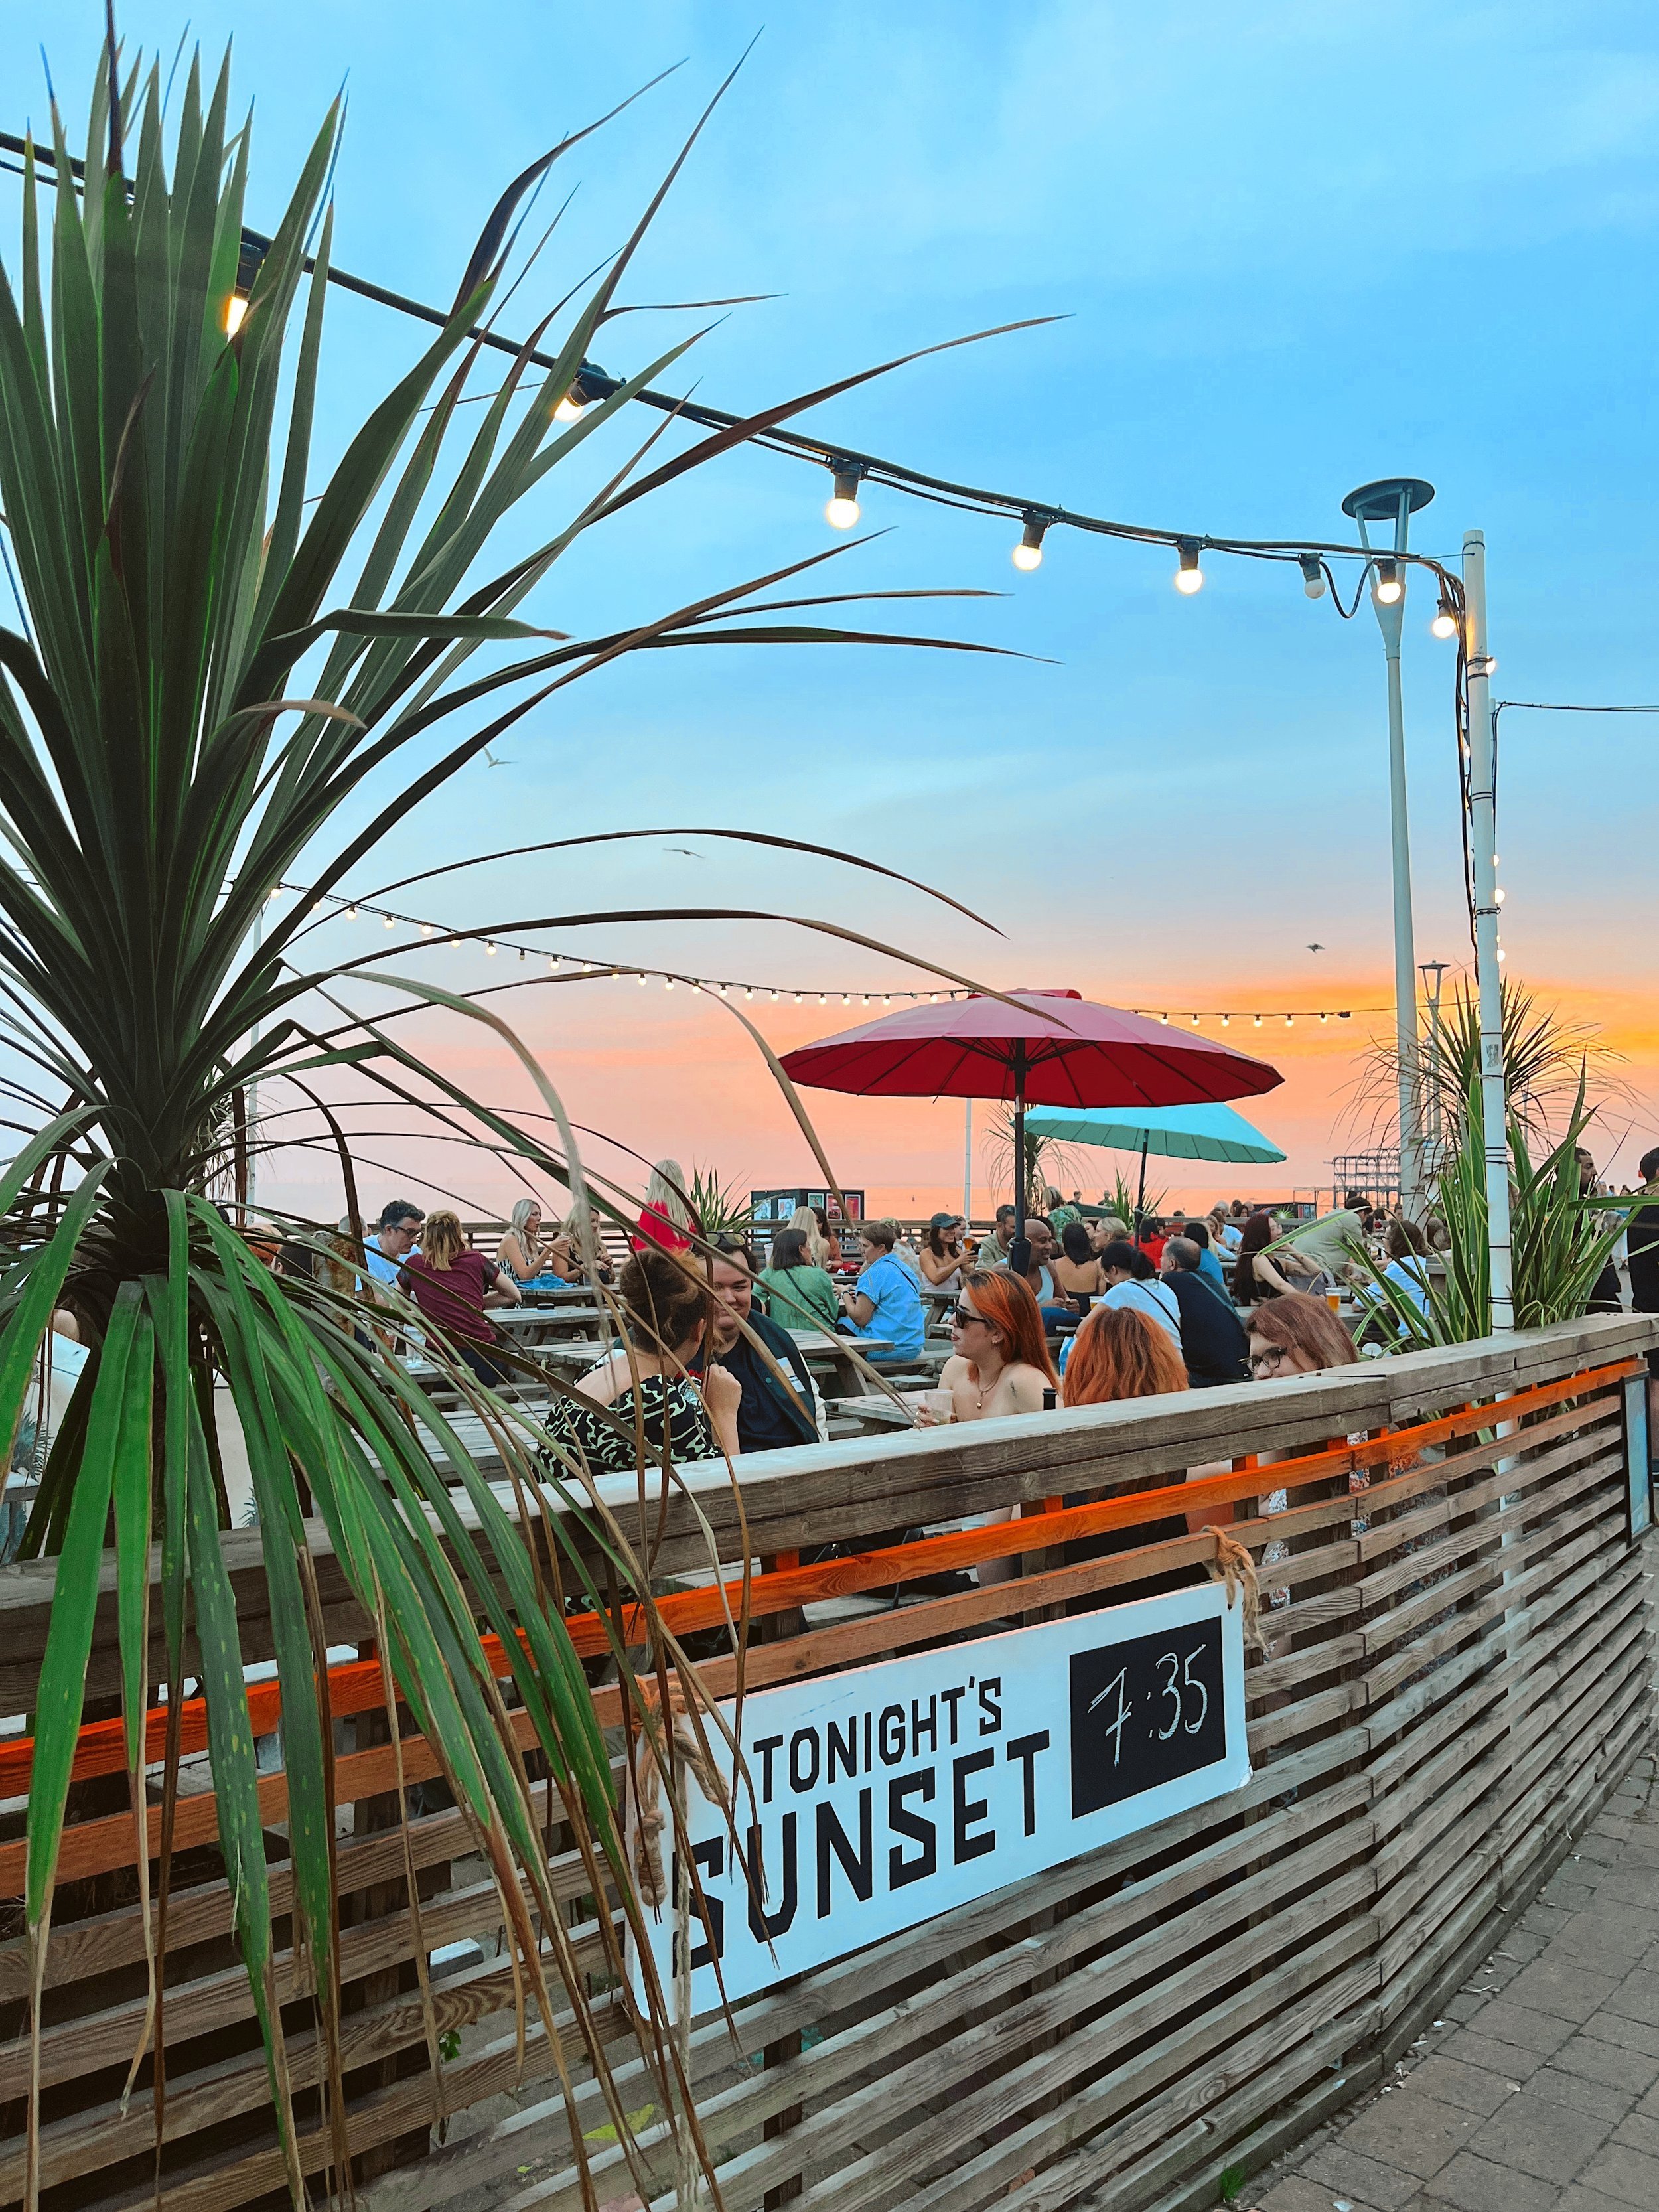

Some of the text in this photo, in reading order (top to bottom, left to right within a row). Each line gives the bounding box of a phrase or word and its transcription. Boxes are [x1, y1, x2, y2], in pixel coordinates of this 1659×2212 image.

[753, 1676, 1001, 1804] TONIGHT'S
[1087, 1643, 1208, 1769] 7:35
[672, 1730, 1050, 1978] SUNSET
